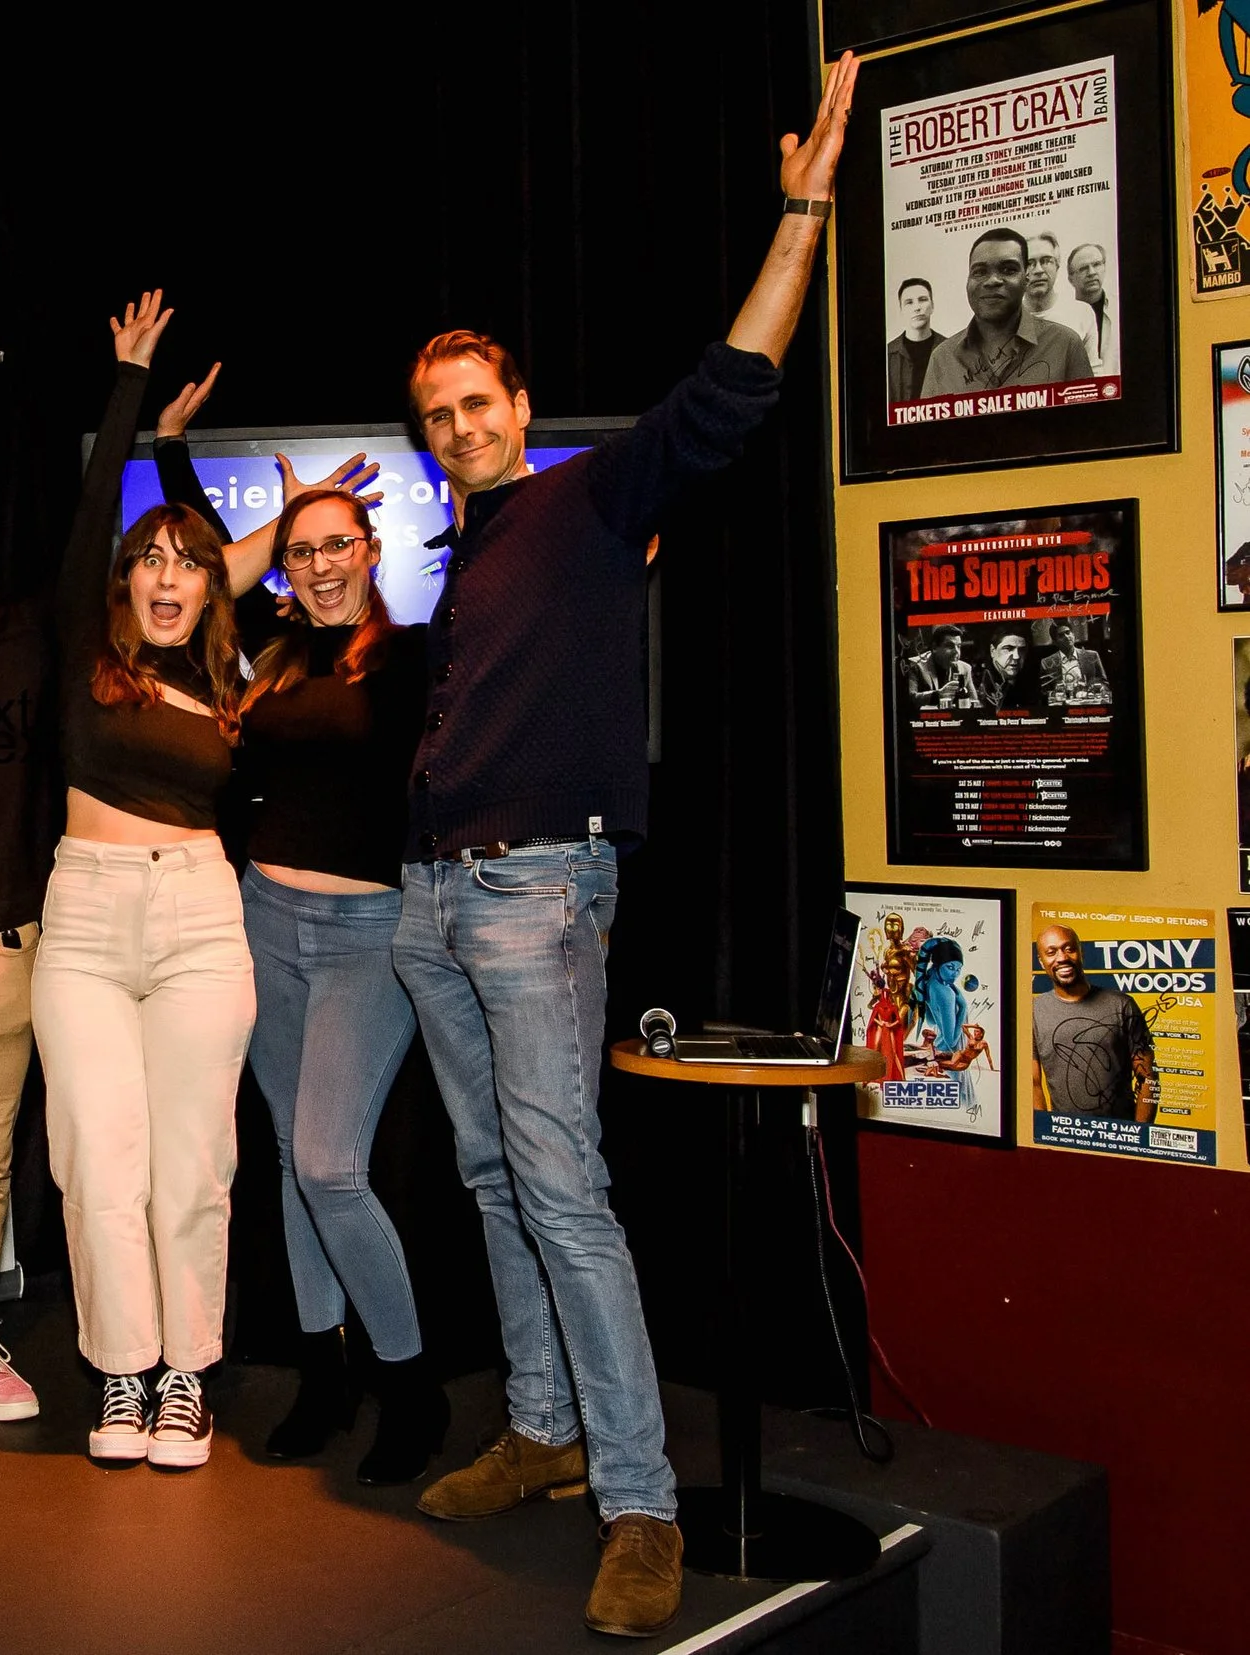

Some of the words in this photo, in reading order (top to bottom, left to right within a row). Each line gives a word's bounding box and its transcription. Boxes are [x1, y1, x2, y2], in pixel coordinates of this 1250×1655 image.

[889, 125, 902, 160] THE
[905, 100, 1007, 155] ROBERT
[1012, 80, 1089, 132] CRAY
[1093, 75, 1108, 116] BAND
[920, 160, 953, 175] SATURDAY
[955, 157, 969, 168] 7TH
[970, 154, 983, 165] FEB
[985, 148, 1013, 161] SYDNEY
[1014, 143, 1043, 156] ENMORE
[1045, 134, 1077, 149] THEATRE
[927, 176, 956, 190] TUESDAY
[957, 172, 976, 184] 10TH
[977, 169, 990, 180] FEB
[992, 162, 1026, 178] BRISBANE
[1028, 158, 1042, 170] THE
[1044, 153, 1067, 167] TIVOLI
[905, 195, 944, 211] WEDNESDAY
[945, 192, 963, 204] 11TH
[964, 189, 977, 200] FEB
[978, 180, 1025, 197] WOLLONGONG
[1026, 174, 1052, 188] YALLAH
[1054, 166, 1093, 182] WOOLSHED
[891, 216, 923, 231] SATURDAY
[925, 212, 942, 225] 14TH
[944, 209, 956, 221] FEB
[958, 206, 980, 218] PERTH
[981, 197, 1022, 213] MOONLIGHT
[1024, 191, 1047, 205] MUSIC
[1048, 191, 1054, 201] &
[1056, 187, 1075, 199] WINE
[1077, 181, 1111, 196] FESTIVAL
[1202, 272, 1241, 288] MAMBO
[895, 402, 951, 424] TICKETS
[954, 399, 973, 417] ON
[978, 395, 1012, 414] SALE
[1016, 390, 1047, 408] NOW
[1037, 535, 1062, 546] WITH
[907, 559, 956, 601] The
[963, 552, 1110, 604] Sopranos
[983, 609, 1026, 621] FEATURING
[1028, 825, 1066, 833] ticketmaster
[1040, 910, 1056, 918] THE
[1058, 911, 1088, 920] URBAN
[1090, 913, 1127, 922] COMEDY
[1129, 915, 1165, 924] LEGEND
[1166, 917, 1208, 927] RETURNS
[1094, 939, 1201, 969] TONY
[1113, 973, 1207, 993] WOODS
[1177, 996, 1203, 1007] USA
[884, 1082, 959, 1098] EMPIRE
[884, 1097, 923, 1107] STRIPS
[926, 1098, 958, 1107] BACK
[1051, 1115, 1072, 1126] WED
[1074, 1118, 1081, 1126] 6
[1090, 1120, 1109, 1130] SAT
[1111, 1123, 1118, 1131] 9
[1120, 1125, 1141, 1134] MAY
[1052, 1125, 1095, 1138] FACTORY
[1098, 1131, 1140, 1144] THEATRE
[1151, 1130, 1171, 1140] SYDNEY
[1172, 1133, 1195, 1143] COMEDY
[1118, 1145, 1207, 1161] SYDNEYCOMEDYFEST.COM.AU
